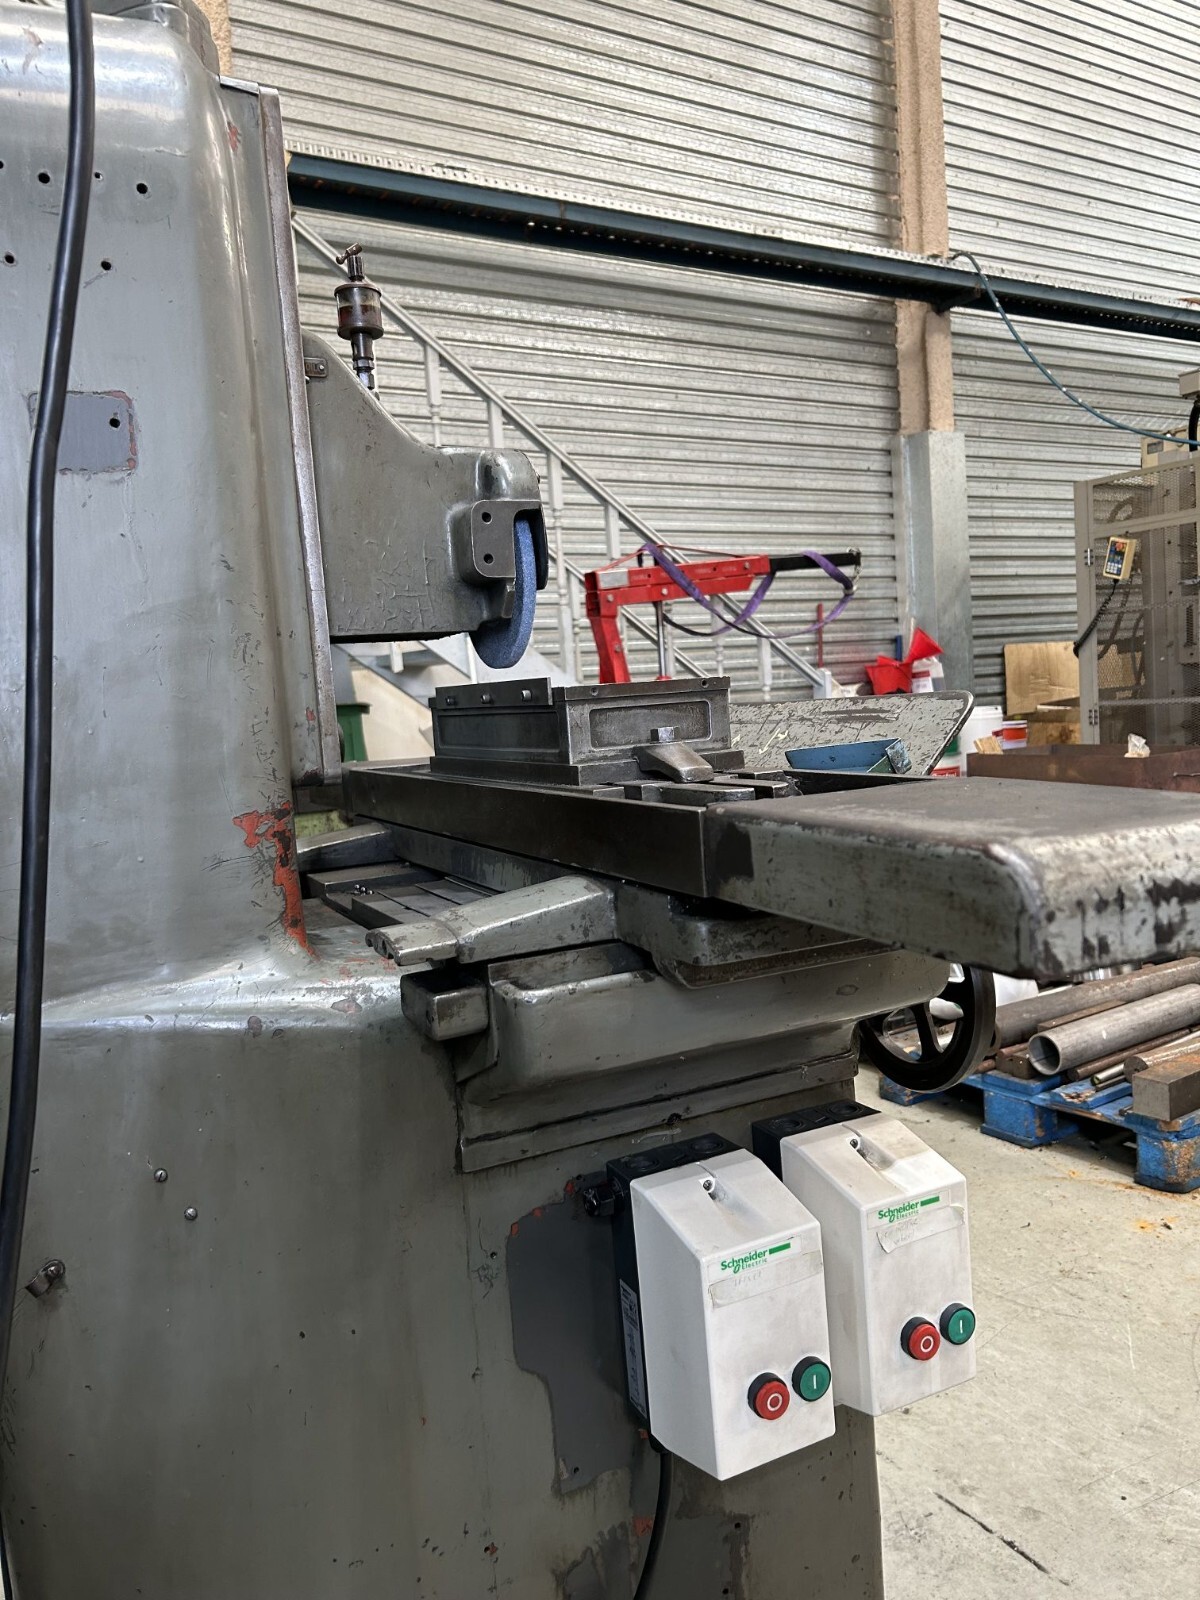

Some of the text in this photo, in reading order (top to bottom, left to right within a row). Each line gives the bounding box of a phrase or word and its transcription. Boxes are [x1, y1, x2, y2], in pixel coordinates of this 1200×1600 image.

[878, 1201, 919, 1223] Schneider
[896, 1209, 919, 1220] Electric
[720, 1249, 768, 1274] Schneider
[741, 1258, 768, 1270] Electric
